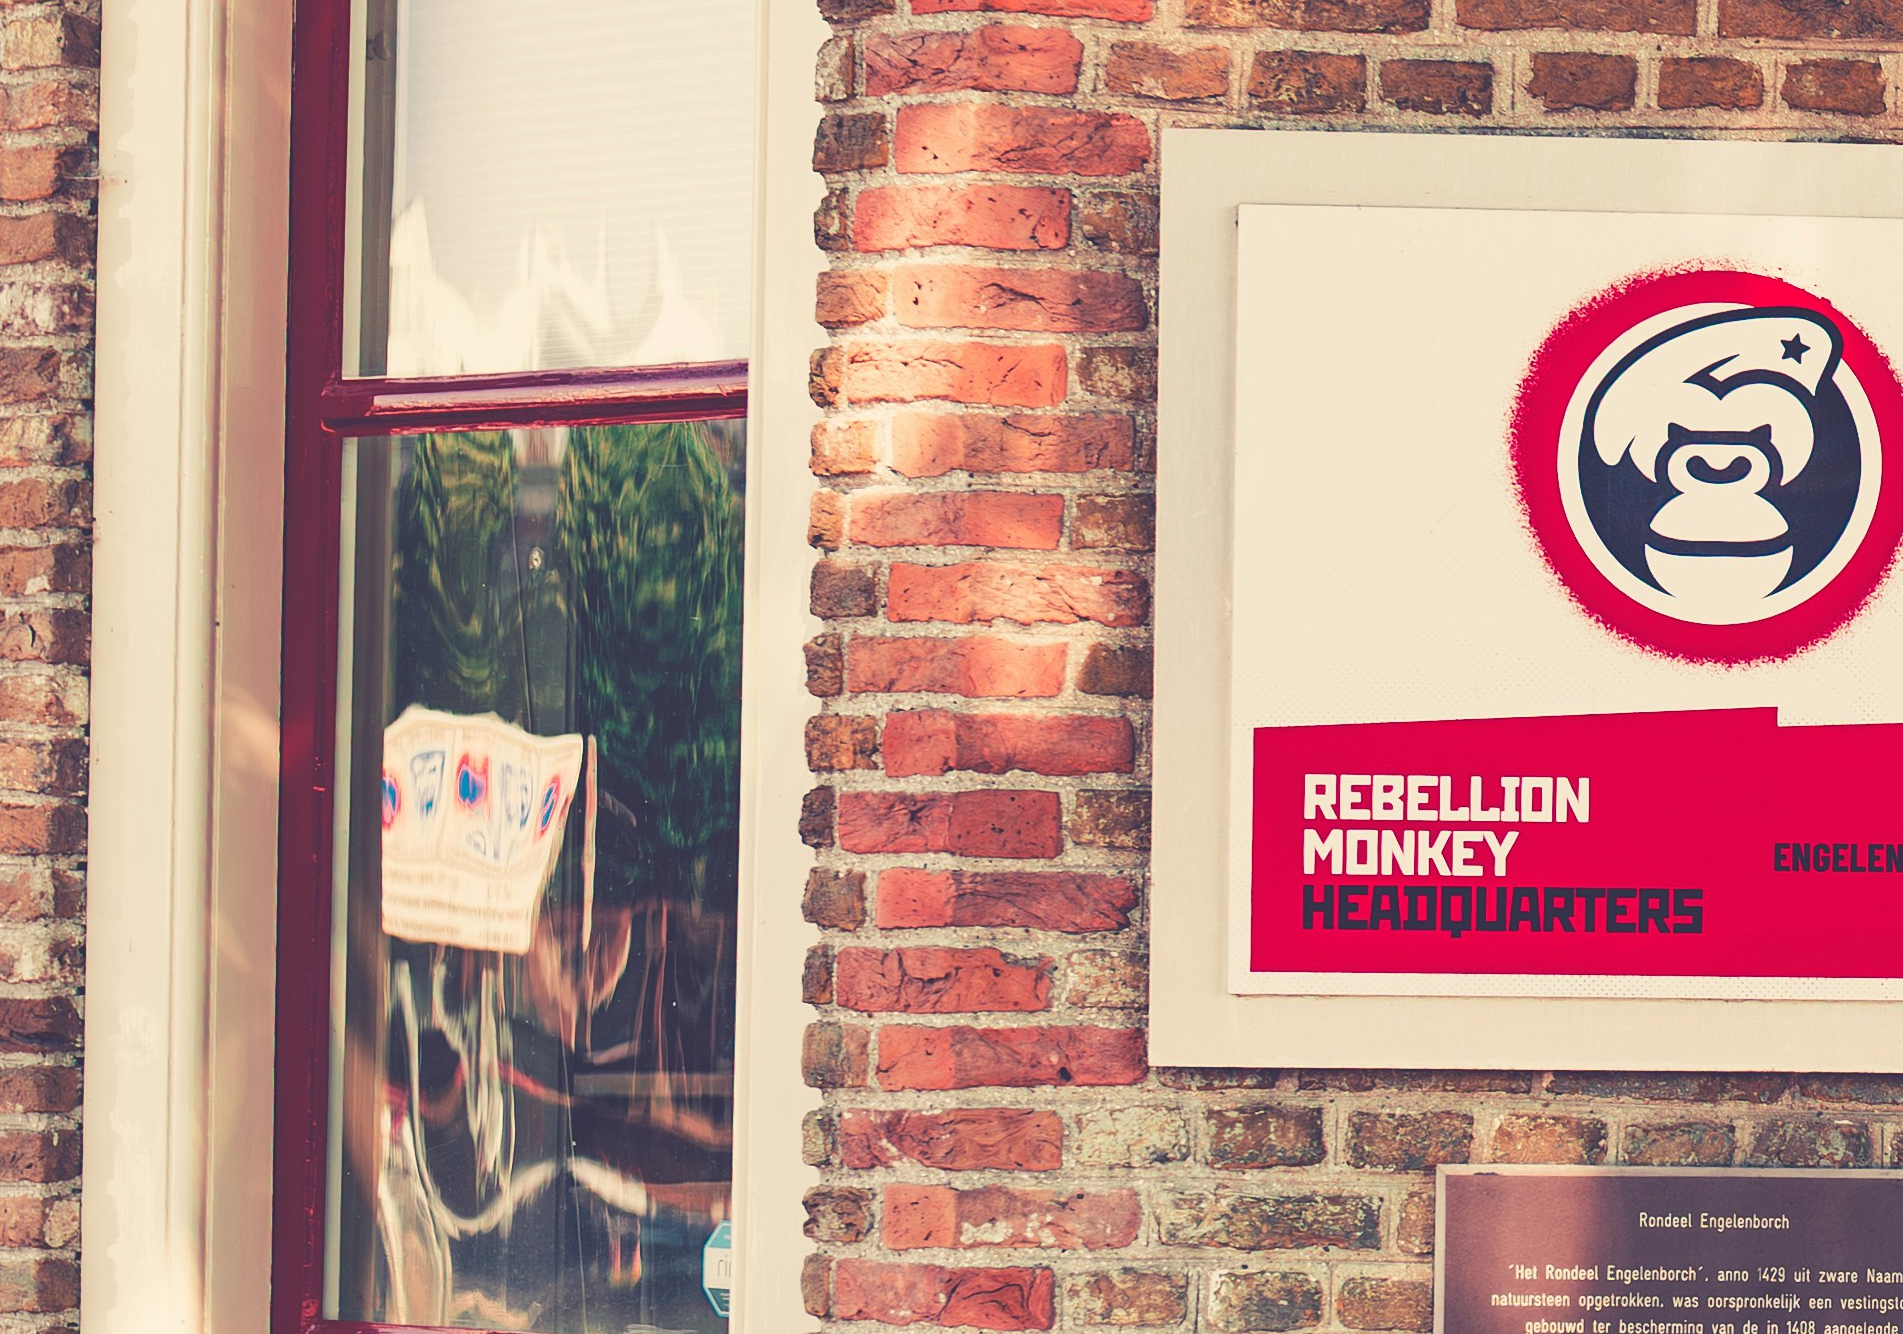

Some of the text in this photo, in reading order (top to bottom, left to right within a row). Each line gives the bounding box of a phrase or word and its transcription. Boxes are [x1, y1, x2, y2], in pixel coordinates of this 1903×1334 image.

[1303, 773, 1590, 823] REBELLION
[1303, 829, 1519, 877] MONKEY
[1302, 884, 1704, 939] HEADQUARTERS
[1639, 1211, 1790, 1233] Rondeel Engelenborch
[1545, 1264, 1599, 1281] Rondeel
[1717, 1269, 1749, 1283] anno
[1756, 1266, 1786, 1283] 1429
[1793, 1267, 1811, 1283] uit
[1818, 1270, 1859, 1284] zware
[1490, 1292, 1571, 1307] natuursteen
[1672, 1296, 1700, 1309] was
[1707, 1293, 1801, 1314] oorspronkelijk
[1808, 1297, 1833, 1310] een
[1592, 1319, 1612, 1334] ter
[1711, 1323, 1735, 1334] van
